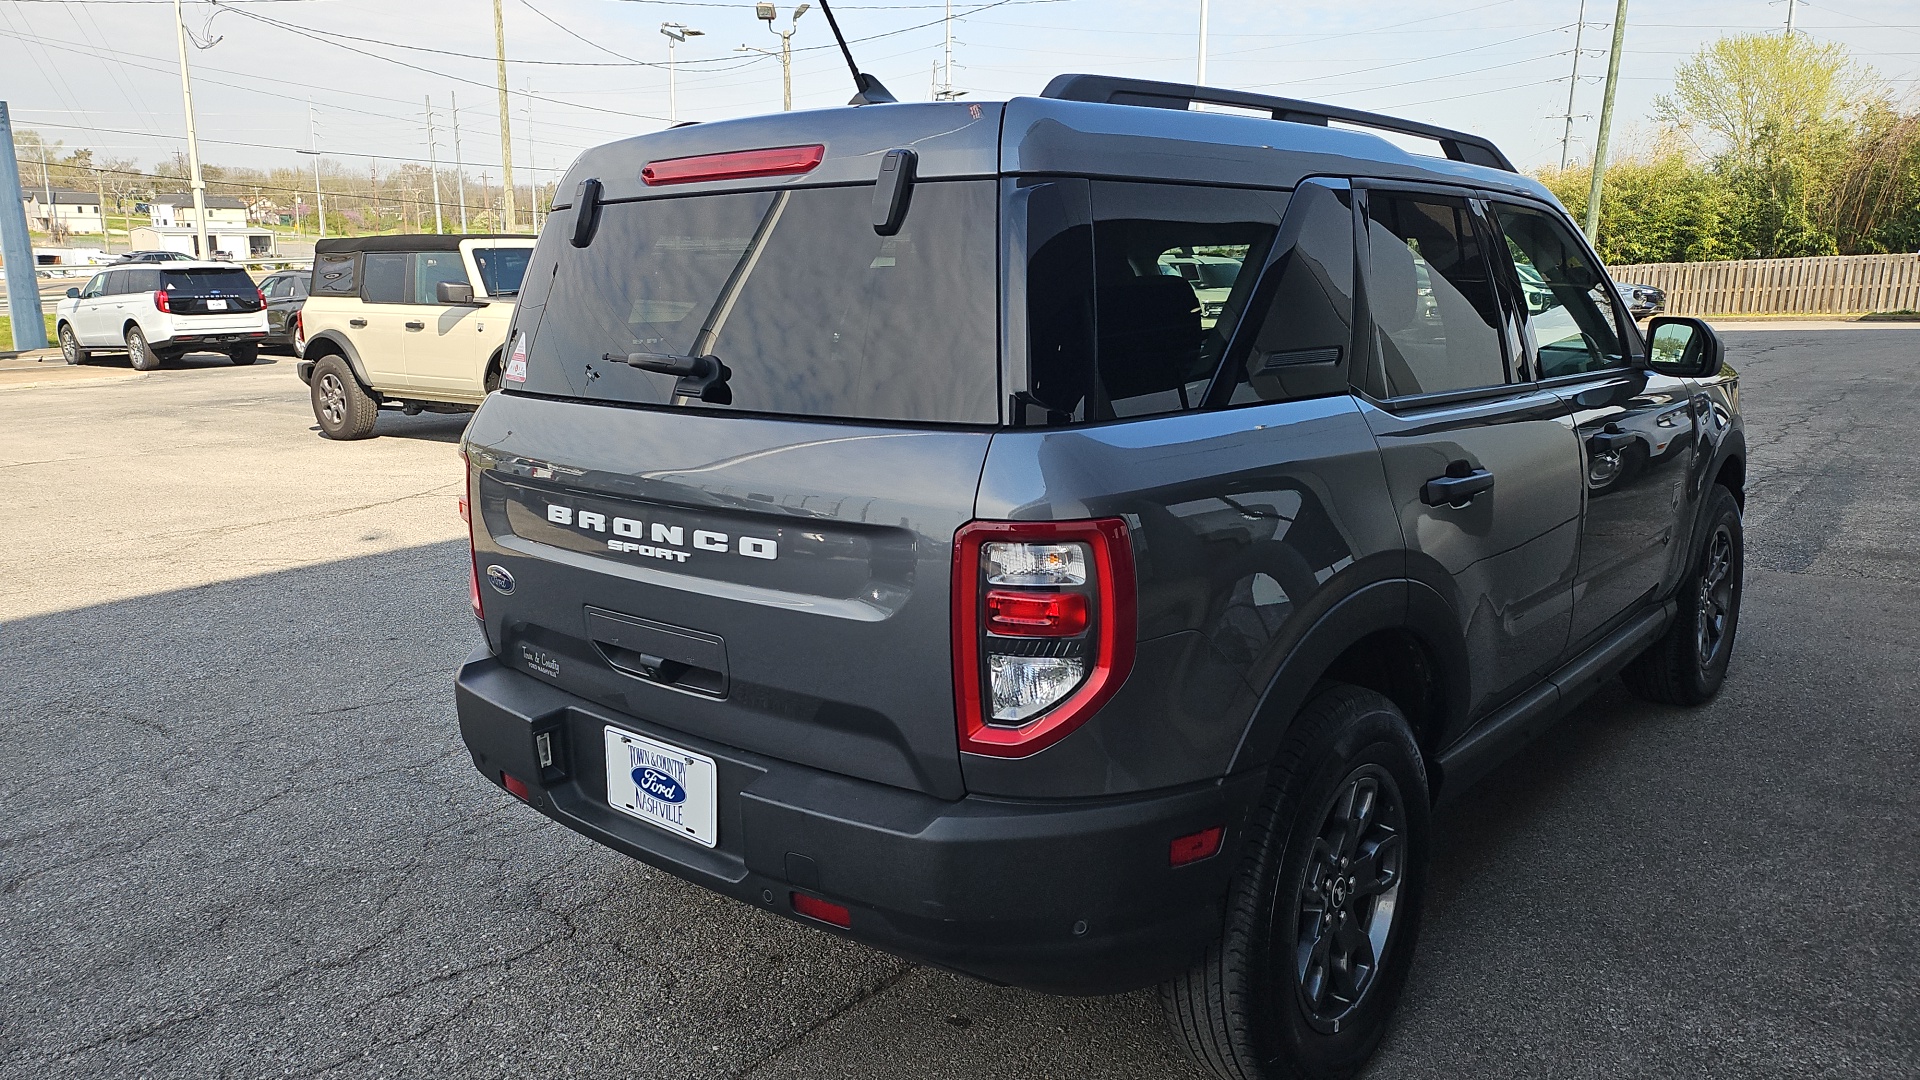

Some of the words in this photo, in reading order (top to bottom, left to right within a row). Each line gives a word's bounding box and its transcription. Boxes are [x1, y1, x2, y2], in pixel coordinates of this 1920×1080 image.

[547, 504, 778, 560] BRONCO
[607, 540, 692, 563] SPORT
[628, 744, 650, 767] TOWN
[650, 752, 657, 767] &
[656, 754, 687, 788] COUNTRY
[641, 769, 676, 800] Ford
[635, 786, 684, 826] NASHVILLE
